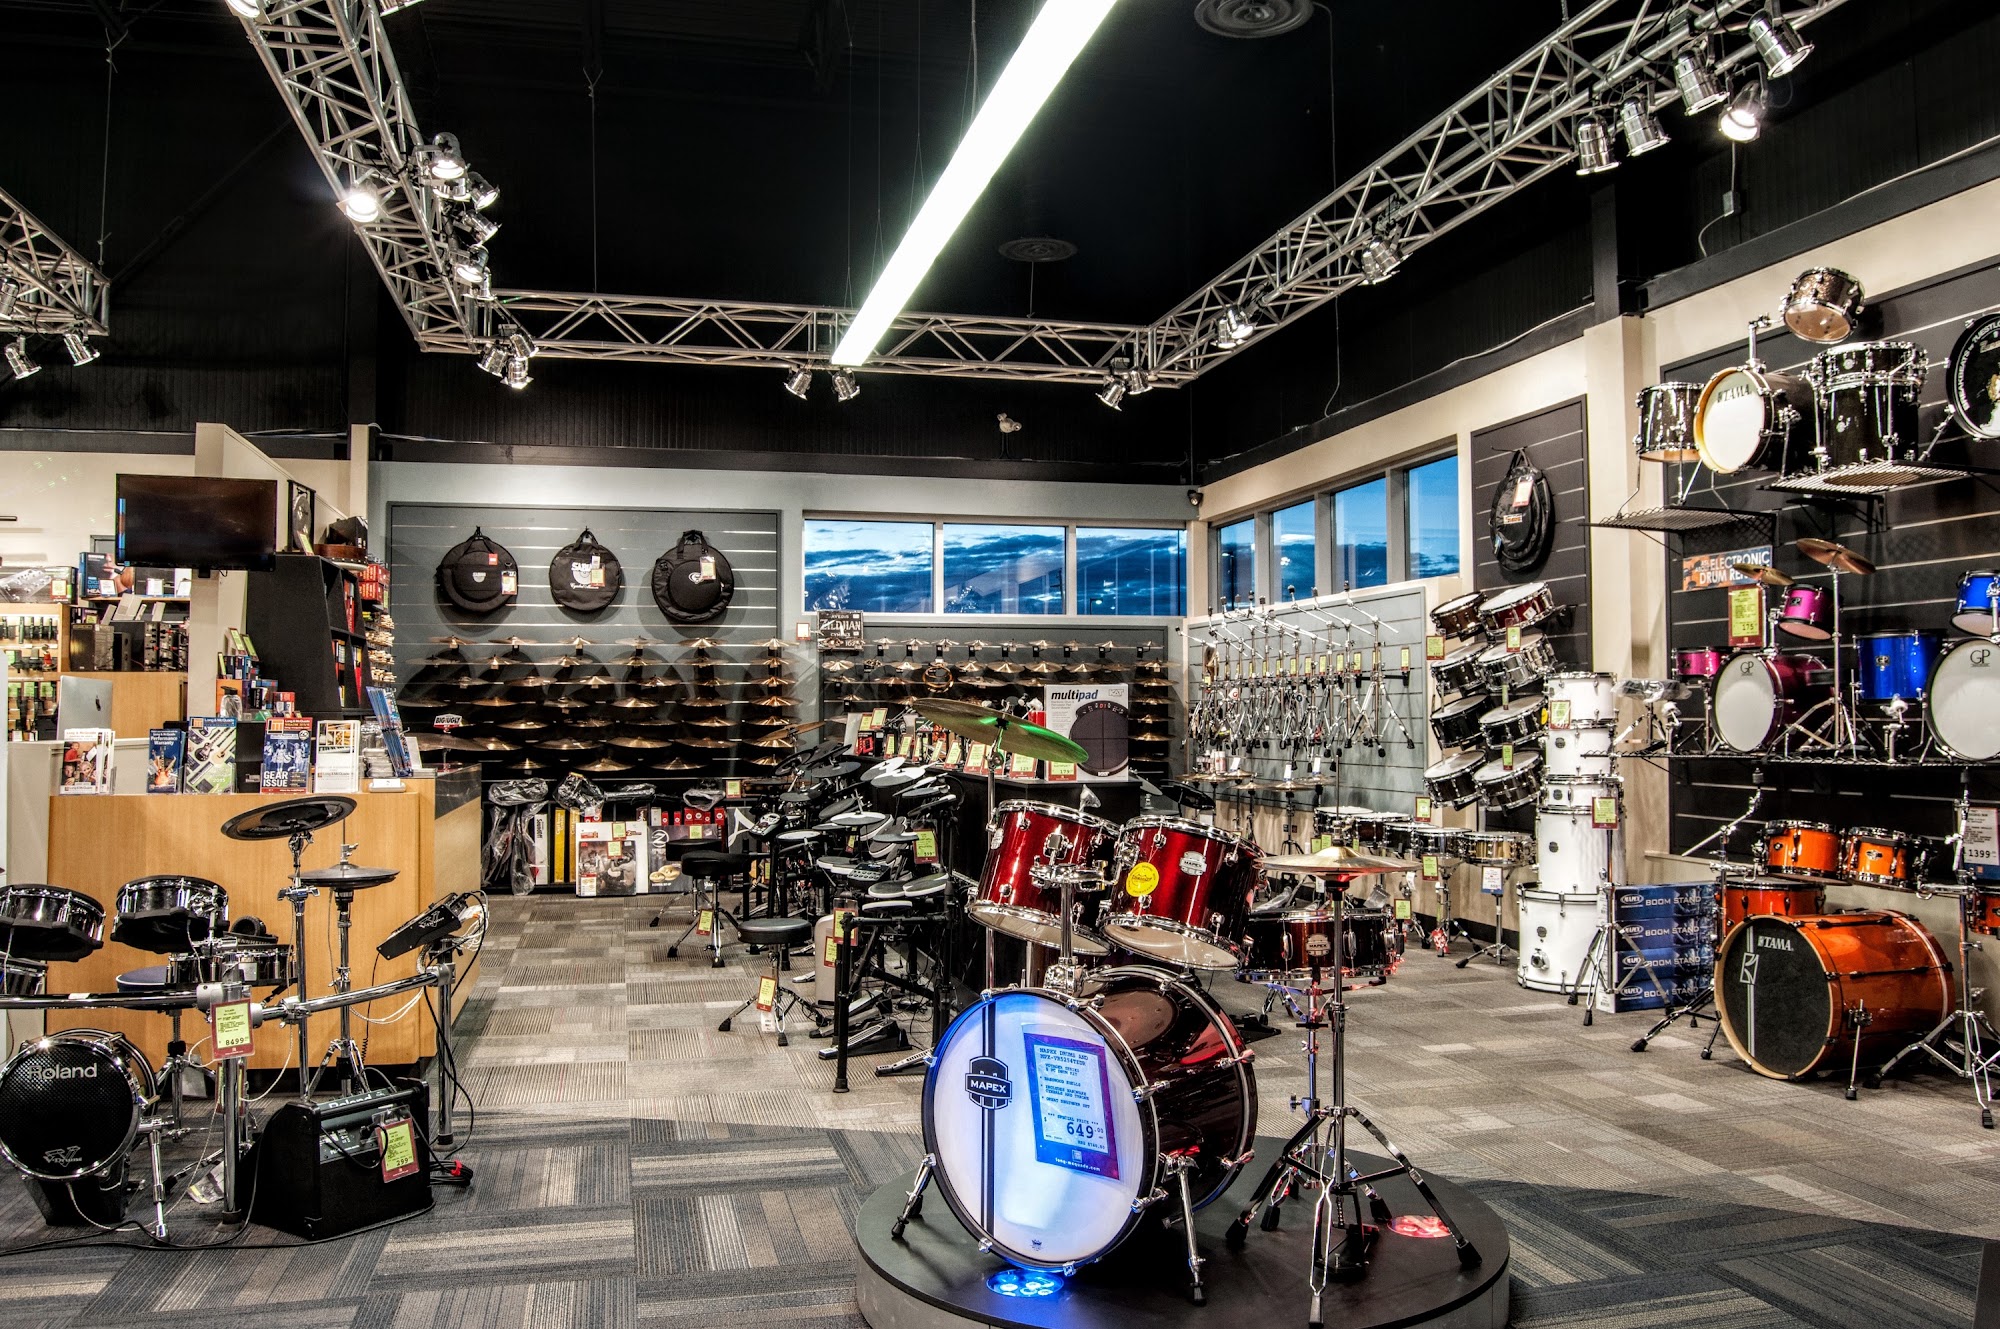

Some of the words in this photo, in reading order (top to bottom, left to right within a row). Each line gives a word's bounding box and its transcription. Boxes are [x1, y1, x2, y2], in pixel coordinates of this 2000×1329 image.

[1723, 384, 1750, 401] TAMA
[1710, 551, 1770, 570] ELECTRONIC
[1699, 570, 1727, 584] DRUM
[1970, 649, 1990, 665] GP
[1740, 661, 1754, 673] GP
[1051, 690, 1098, 702] multipad
[1108, 688, 1124, 697] KAT
[264, 771, 288, 780] GEAR
[1968, 849, 1990, 858] 1399
[1645, 898, 1671, 906] BOOM
[1673, 896, 1702, 904] STAND
[1764, 936, 1791, 951] TAMA
[1646, 959, 1672, 967] BOOM
[1673, 957, 1701, 965] STAND
[1672, 987, 1699, 995] STAND
[1040, 1047, 1057, 1055] MAPEX
[1059, 1050, 1076, 1058] DRUMS
[29, 1063, 98, 1079] Roland
[971, 1080, 1007, 1094] MAPEX
[1057, 1114, 1075, 1122] SPECIAL
[1075, 1117, 1090, 1125] PRICE
[1066, 1121, 1094, 1139] 649
[396, 1157, 409, 1166] 299
[1055, 1157, 1101, 1172] long-mcquade.com
